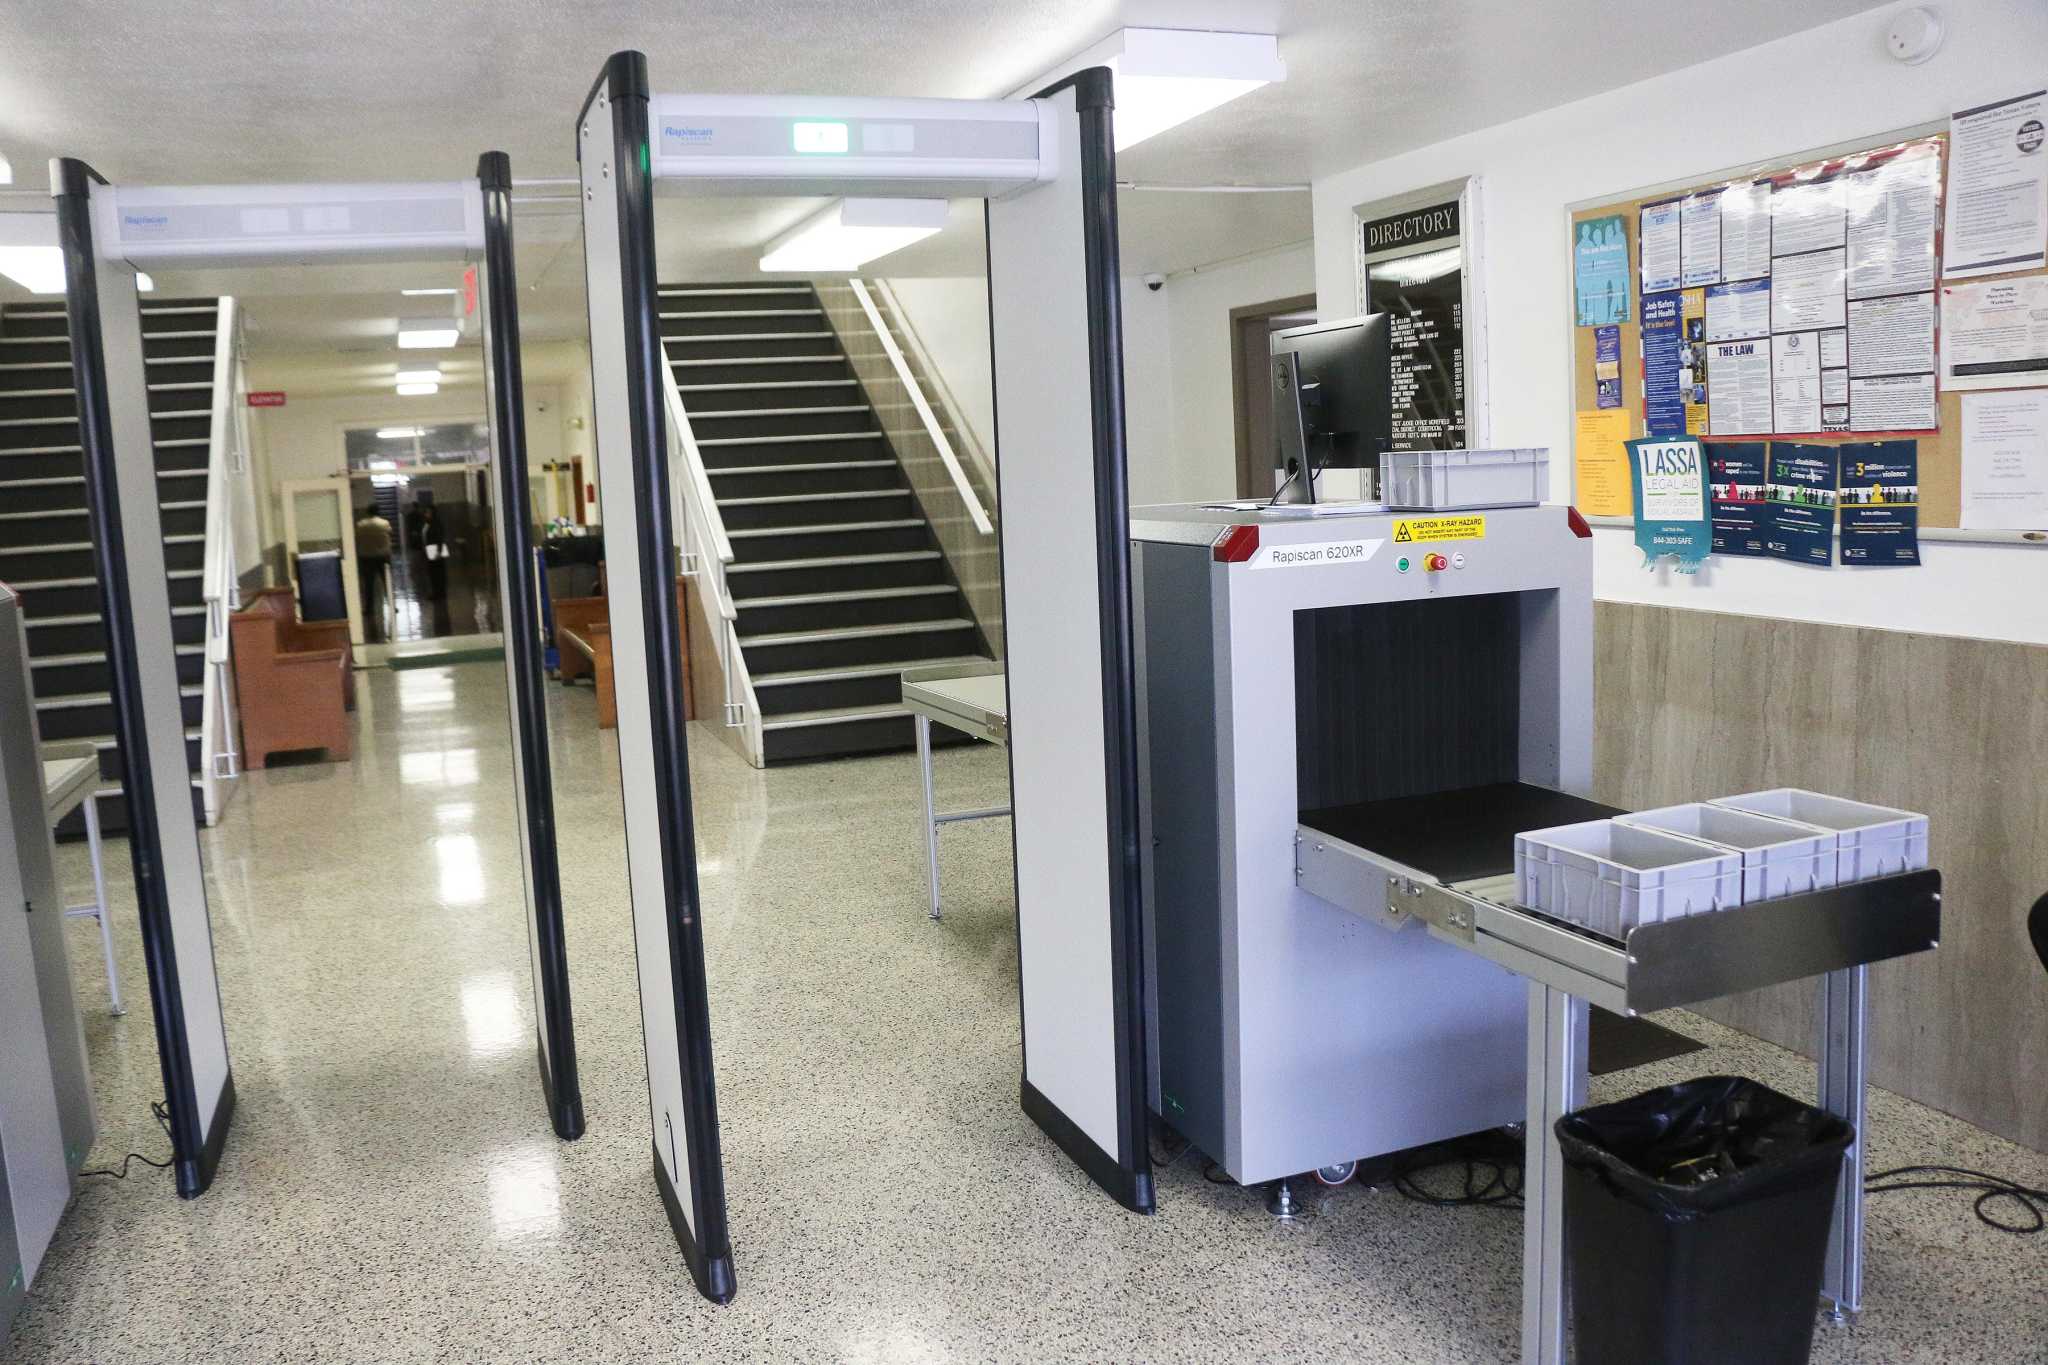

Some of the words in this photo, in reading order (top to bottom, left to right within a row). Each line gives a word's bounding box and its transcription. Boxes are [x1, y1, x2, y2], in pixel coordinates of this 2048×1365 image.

[664, 126, 713, 138] Rapiscan
[1369, 207, 1454, 247] DIRECTORY
[1645, 301, 1657, 311] Job
[1658, 299, 1675, 309] Safety
[1646, 311, 1657, 319] and
[1659, 309, 1676, 318] Health
[1718, 346, 1733, 357] THE
[1735, 344, 1754, 356] LAW
[1643, 447, 1698, 477] LASSA
[1855, 462, 1865, 477] 3
[1864, 463, 1885, 471] million
[1645, 478, 1680, 490] LEGAL
[1682, 478, 1699, 490] AID
[1440, 519, 1457, 527] X-RAY
[1458, 518, 1482, 526] HAZARD
[1272, 549, 1323, 564] Rapiscan
[1326, 545, 1364, 560] 620XR
